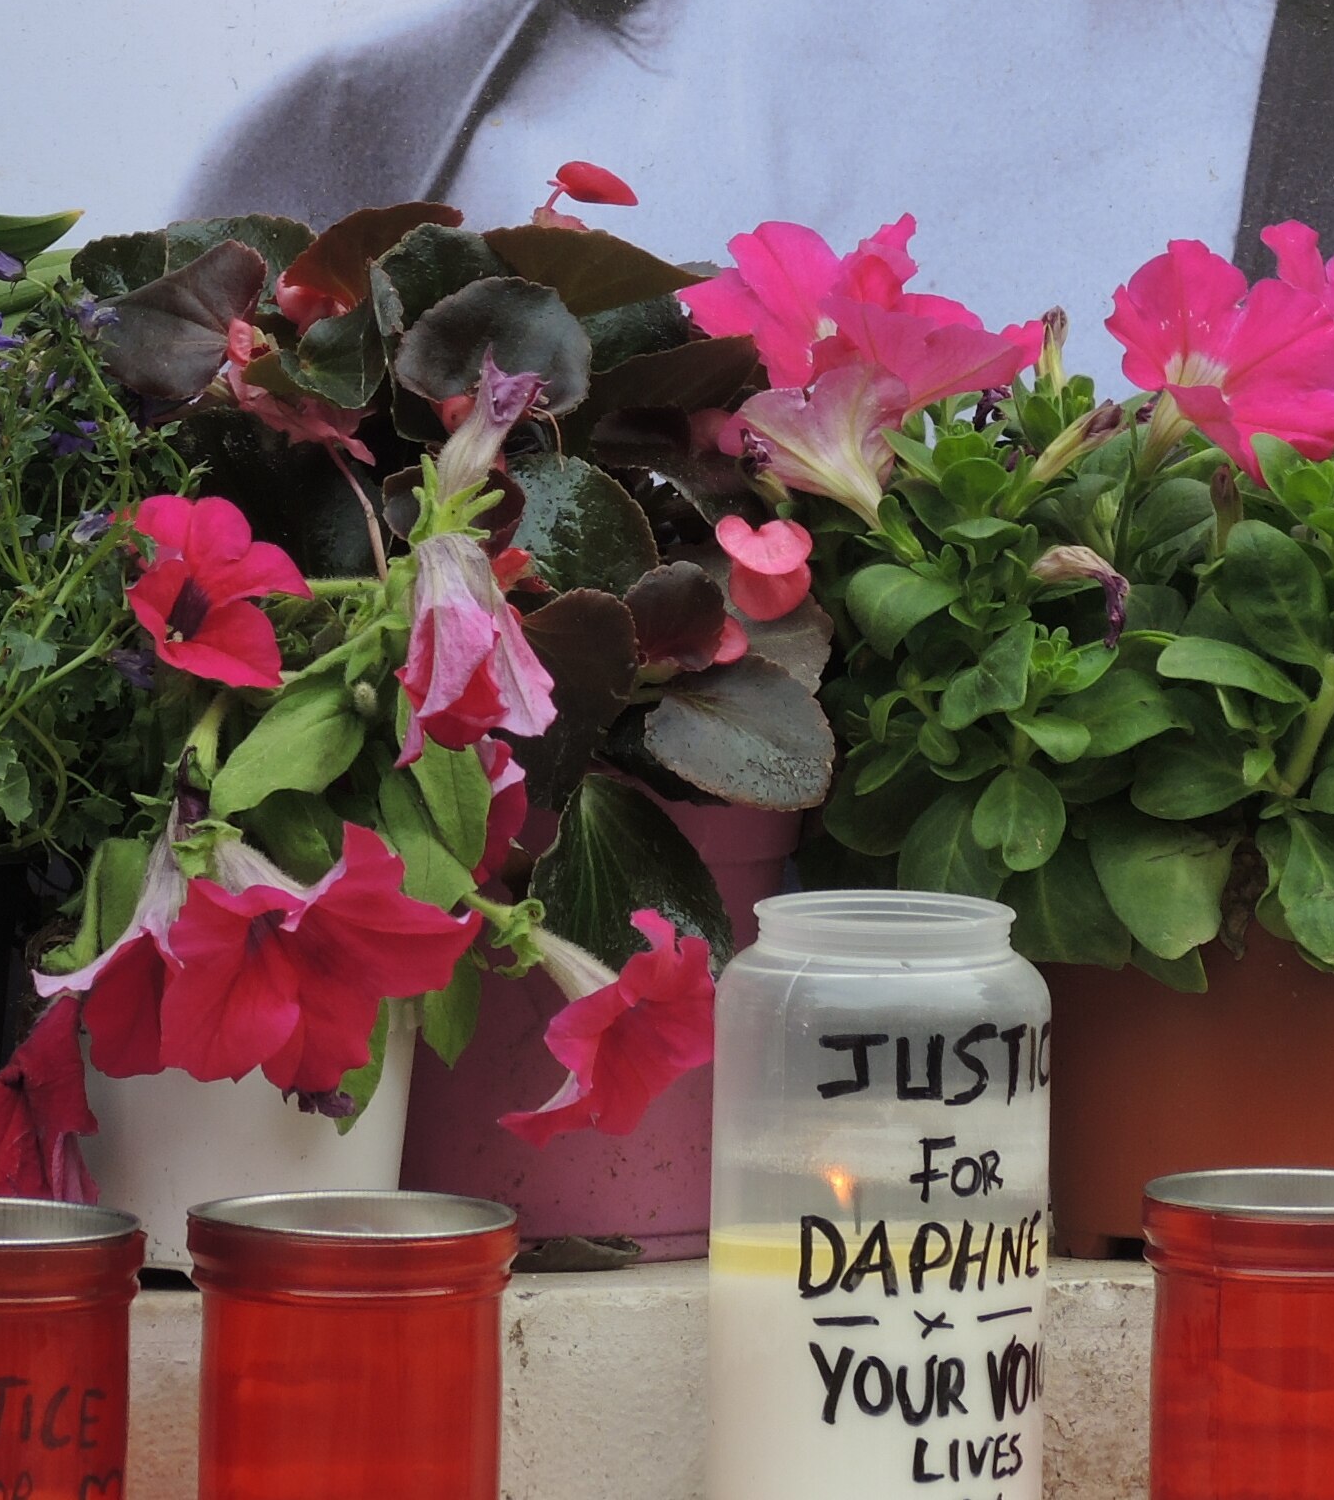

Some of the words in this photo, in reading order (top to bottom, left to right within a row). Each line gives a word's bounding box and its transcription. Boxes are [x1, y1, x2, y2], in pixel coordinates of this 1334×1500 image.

[909, 1135, 1004, 1204] FOR
[797, 1209, 1043, 1298] DAPHNE
[808, 1341, 969, 1427] YOUR
[912, 1432, 1023, 1482] LIVES
